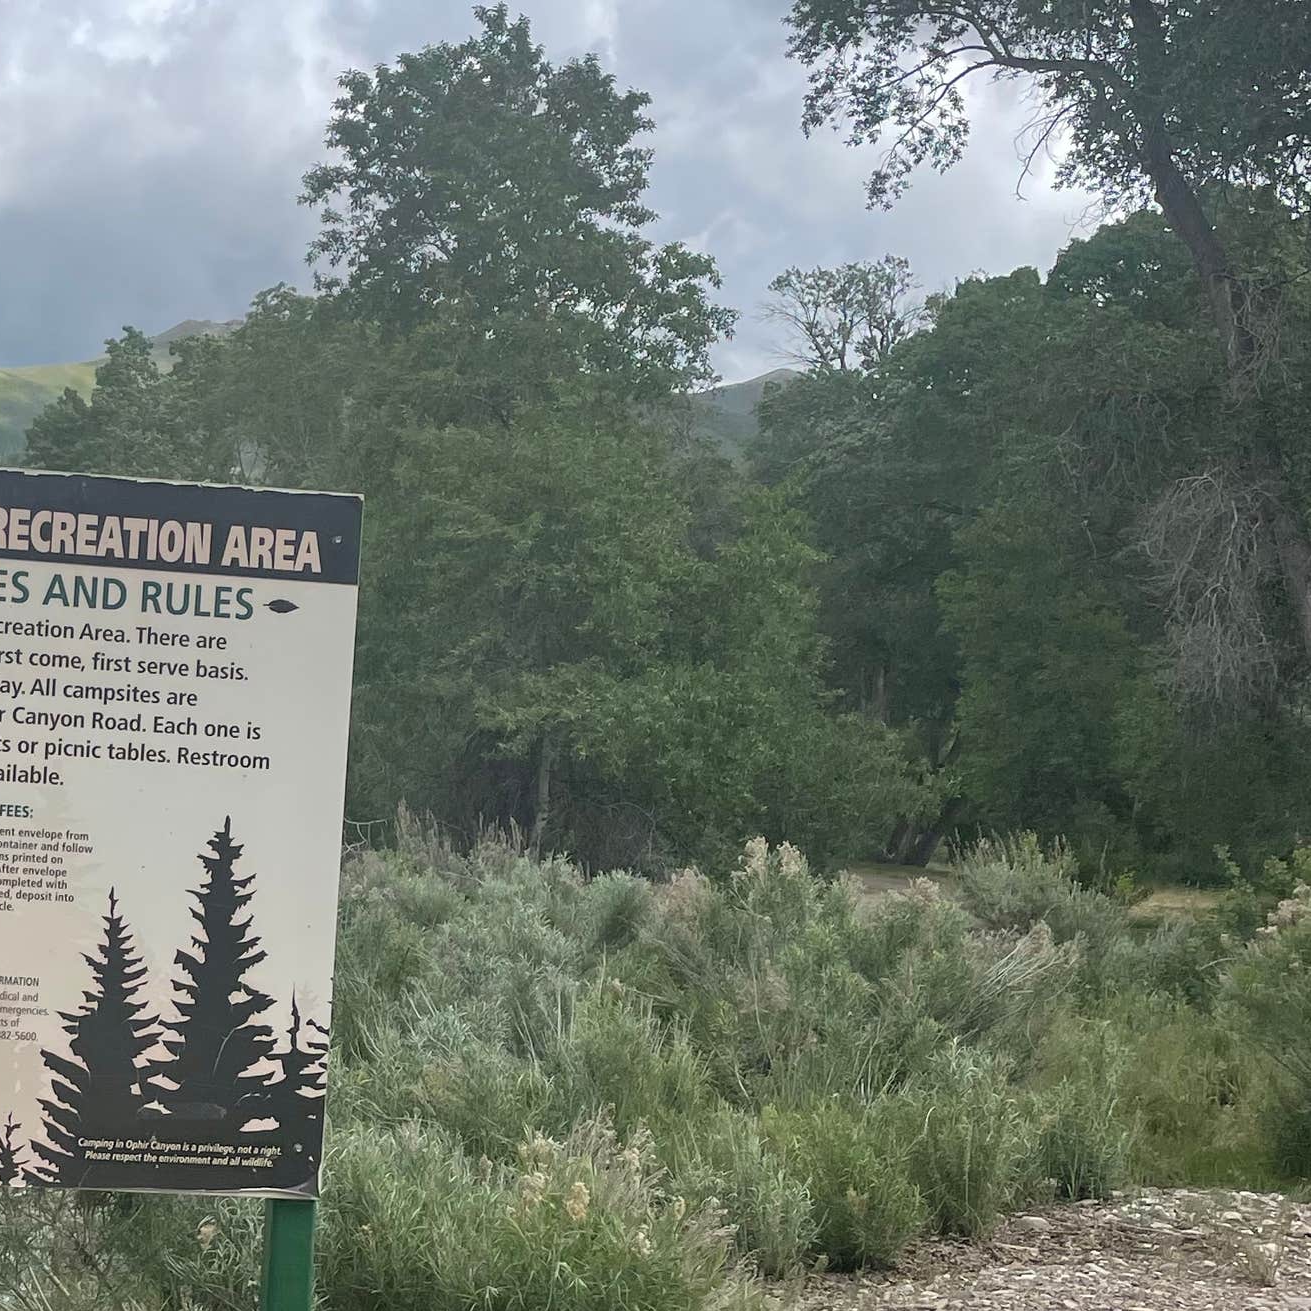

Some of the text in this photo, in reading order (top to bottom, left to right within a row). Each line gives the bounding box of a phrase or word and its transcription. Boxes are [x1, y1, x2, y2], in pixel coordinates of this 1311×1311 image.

[222, 526, 322, 573] AREA
[43, 574, 127, 609] AND
[142, 581, 253, 619] RULES
[79, 623, 130, 643] Area.
[135, 627, 190, 647] There
[196, 635, 227, 650] are
[29, 653, 85, 671] come,
[92, 652, 131, 672] first
[138, 661, 189, 676] serve
[196, 659, 248, 680] basis.
[30, 678, 56, 696] All
[63, 684, 160, 704] campsites
[167, 692, 197, 706] are
[12, 707, 84, 730] Canyon
[92, 712, 146, 732] Road.
[154, 716, 197, 735] Each
[204, 724, 240, 738] one
[247, 721, 260, 740] is
[18, 740, 38, 754] or
[45, 738, 101, 759] picnic
[107, 743, 170, 763] tables.
[178, 747, 269, 769] Restroom
[18, 829, 62, 841] envelope
[66, 830, 89, 840] from
[12, 853, 47, 863] printed
[51, 856, 63, 864] on
[41, 842, 59, 851] and
[62, 842, 93, 853] follow
[22, 866, 67, 878] envelope
[45, 880, 67, 889] with
[22, 993, 38, 1002] and
[78, 1137, 114, 1150] Camping
[125, 1140, 149, 1150] Ophir
[149, 1139, 181, 1152] Canyon
[237, 1146, 252, 1154] not
